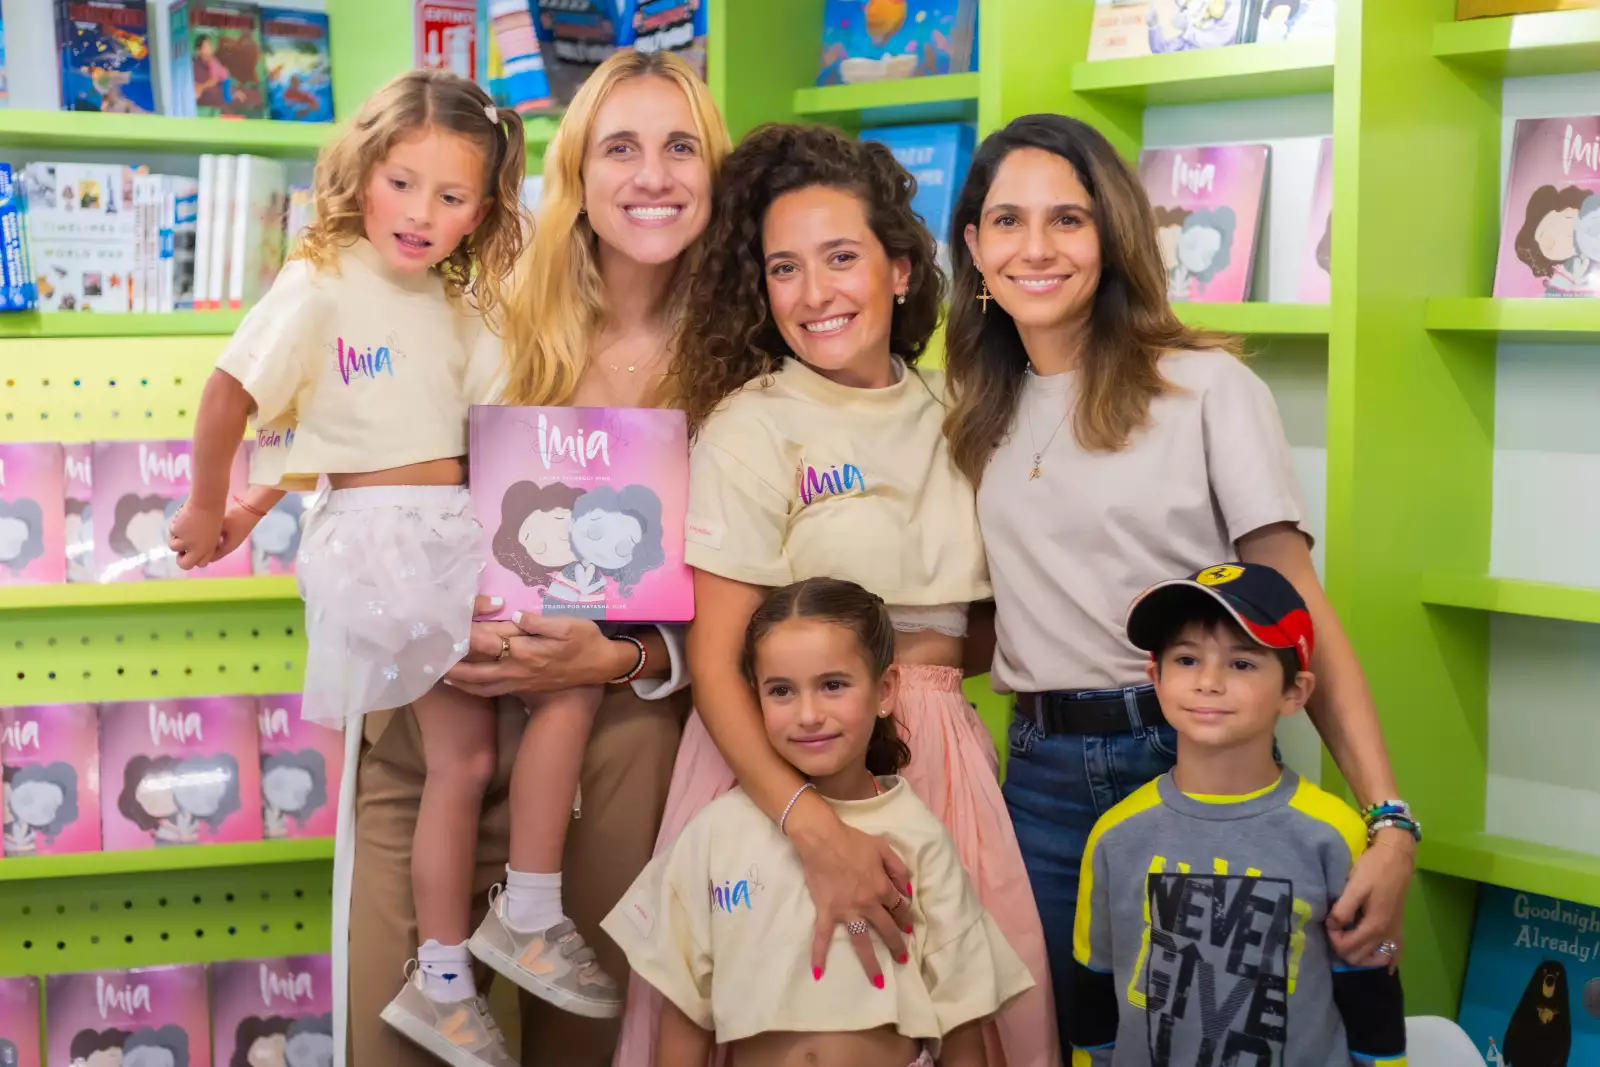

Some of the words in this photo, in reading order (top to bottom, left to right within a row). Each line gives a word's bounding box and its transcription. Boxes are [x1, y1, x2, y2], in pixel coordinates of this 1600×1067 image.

[1562, 124, 1600, 175] Mi
[337, 337, 393, 386] Mia
[257, 428, 281, 449] Toda
[536, 413, 611, 470] Mia
[800, 463, 866, 505] Mia
[150, 703, 203, 746] Mia
[1150, 872, 1291, 976] NEVER
[1512, 893, 1600, 933] Goodnigh
[1514, 924, 1600, 963] Already!
[96, 976, 151, 1020] Mia
[259, 963, 313, 1007] Mia
